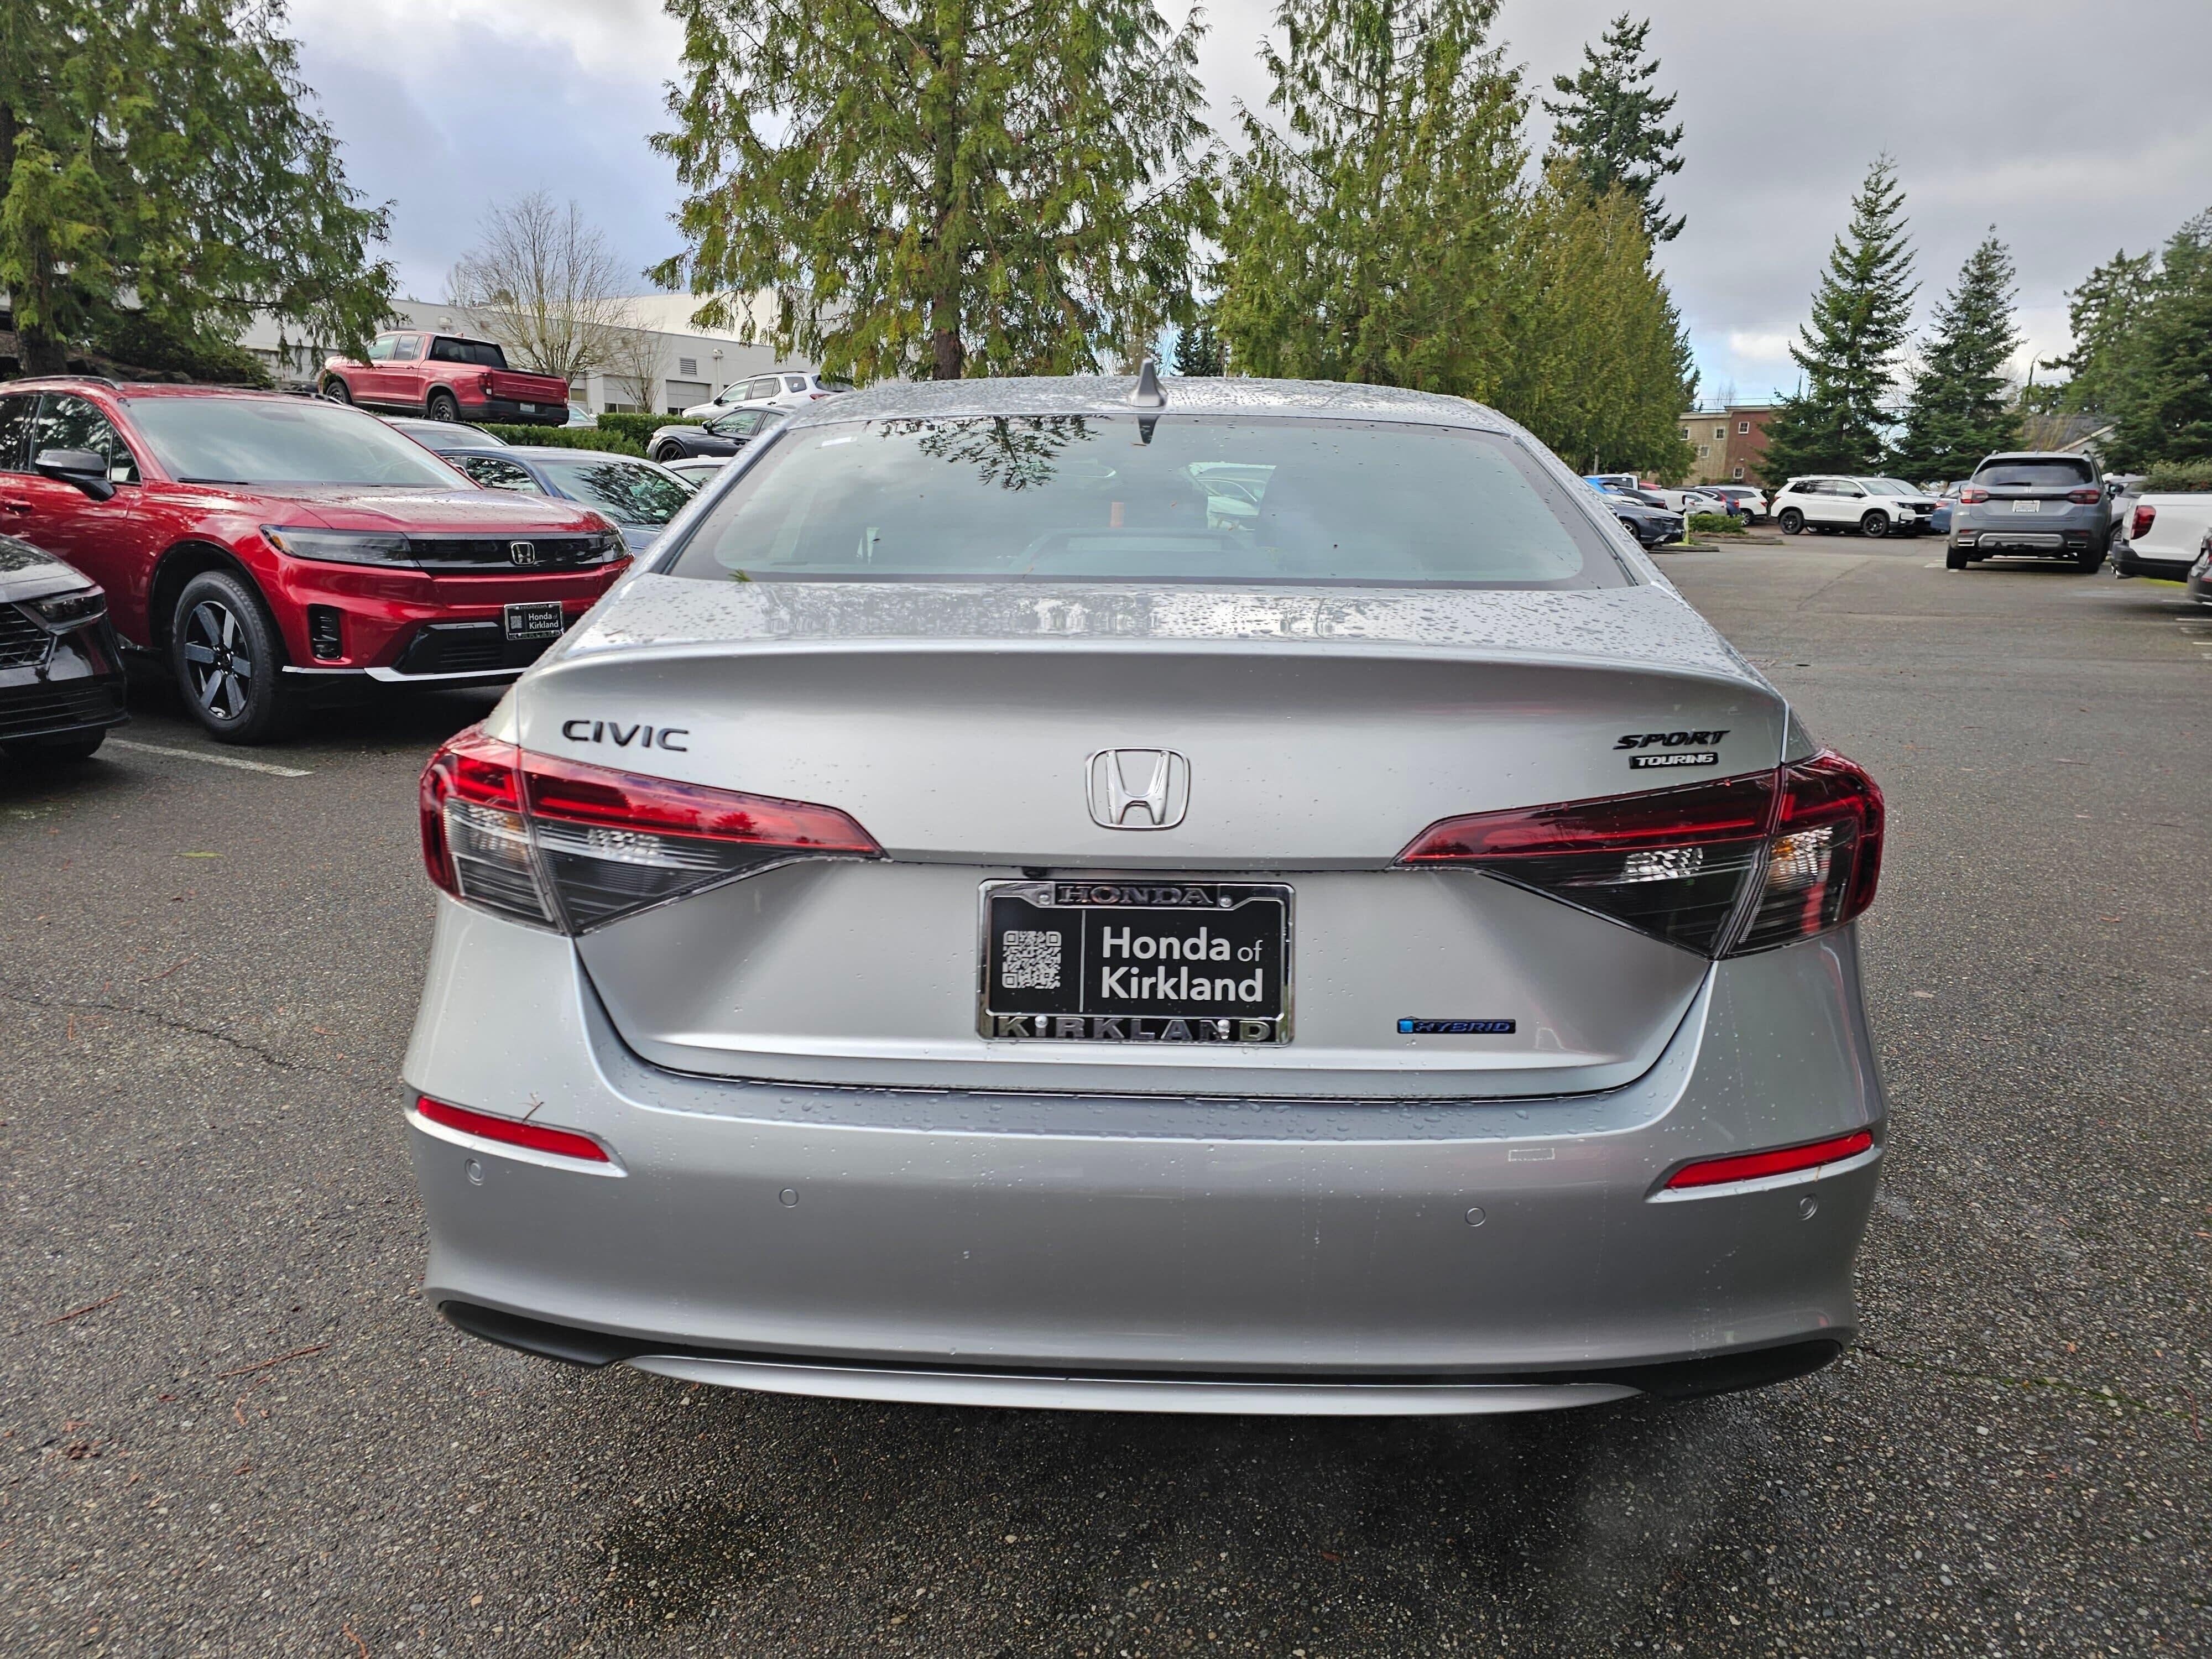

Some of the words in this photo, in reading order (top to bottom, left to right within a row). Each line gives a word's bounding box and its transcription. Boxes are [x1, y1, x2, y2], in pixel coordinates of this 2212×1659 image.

[528, 612, 552, 620] Honda
[529, 620, 559, 629] Kirkland
[562, 720, 688, 752] CIVIC
[1613, 730, 1731, 750] SPORT
[1635, 754, 1714, 766] TOURING
[1057, 886, 1214, 904] HONDA
[1103, 926, 1230, 961] Honda
[1237, 940, 1263, 962] of
[1102, 966, 1263, 1002] Kirkland
[1415, 1021, 1511, 1032] HYBRID
